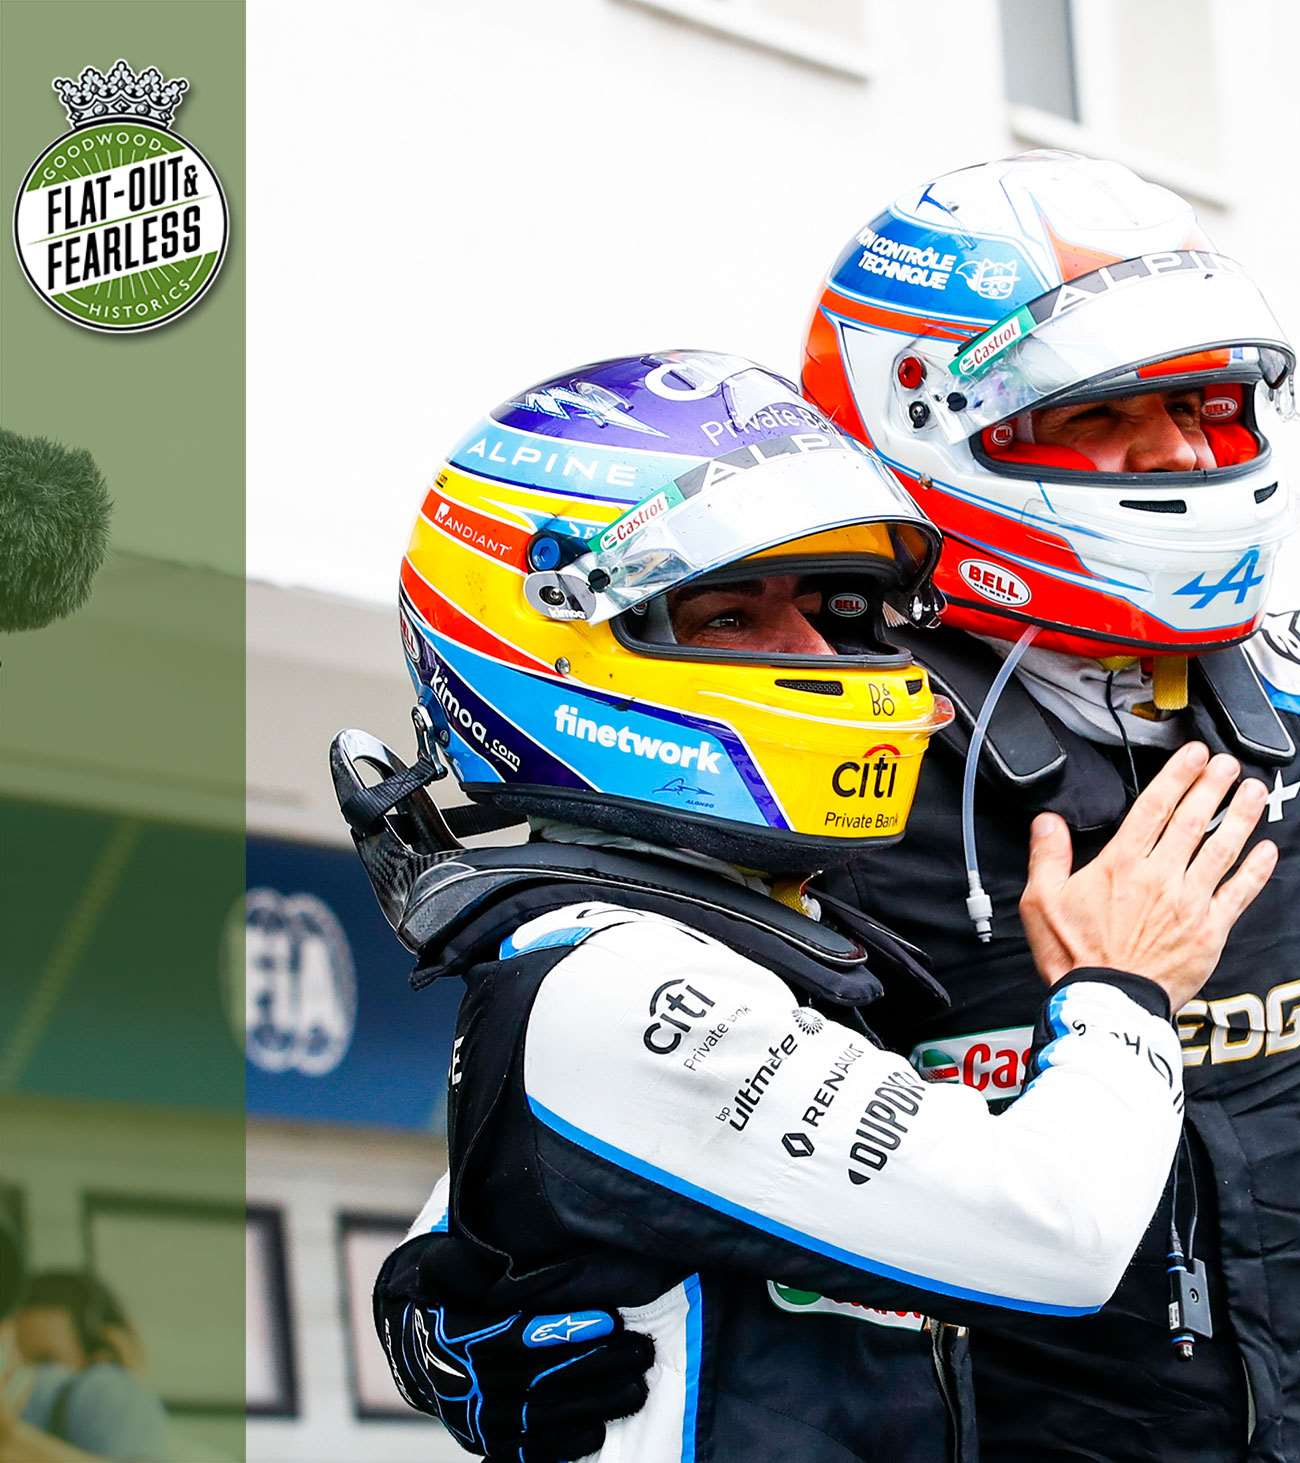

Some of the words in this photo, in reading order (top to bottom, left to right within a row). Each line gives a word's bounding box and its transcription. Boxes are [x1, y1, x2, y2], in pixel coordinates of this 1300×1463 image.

[858, 251, 950, 290] TECHNIQUE
[974, 323, 1016, 365] Castrol
[466, 438, 637, 487] ALPINE
[617, 498, 664, 541] Castrol
[969, 565, 1019, 599] BELL
[554, 704, 723, 775] finetwork
[824, 812, 873, 829] Private
[875, 813, 899, 829] Bank
[683, 1023, 729, 1072] Private
[729, 1033, 799, 1132] ultimate
[802, 1043, 865, 1128] RENAULT
[715, 1106, 731, 1122] bp
